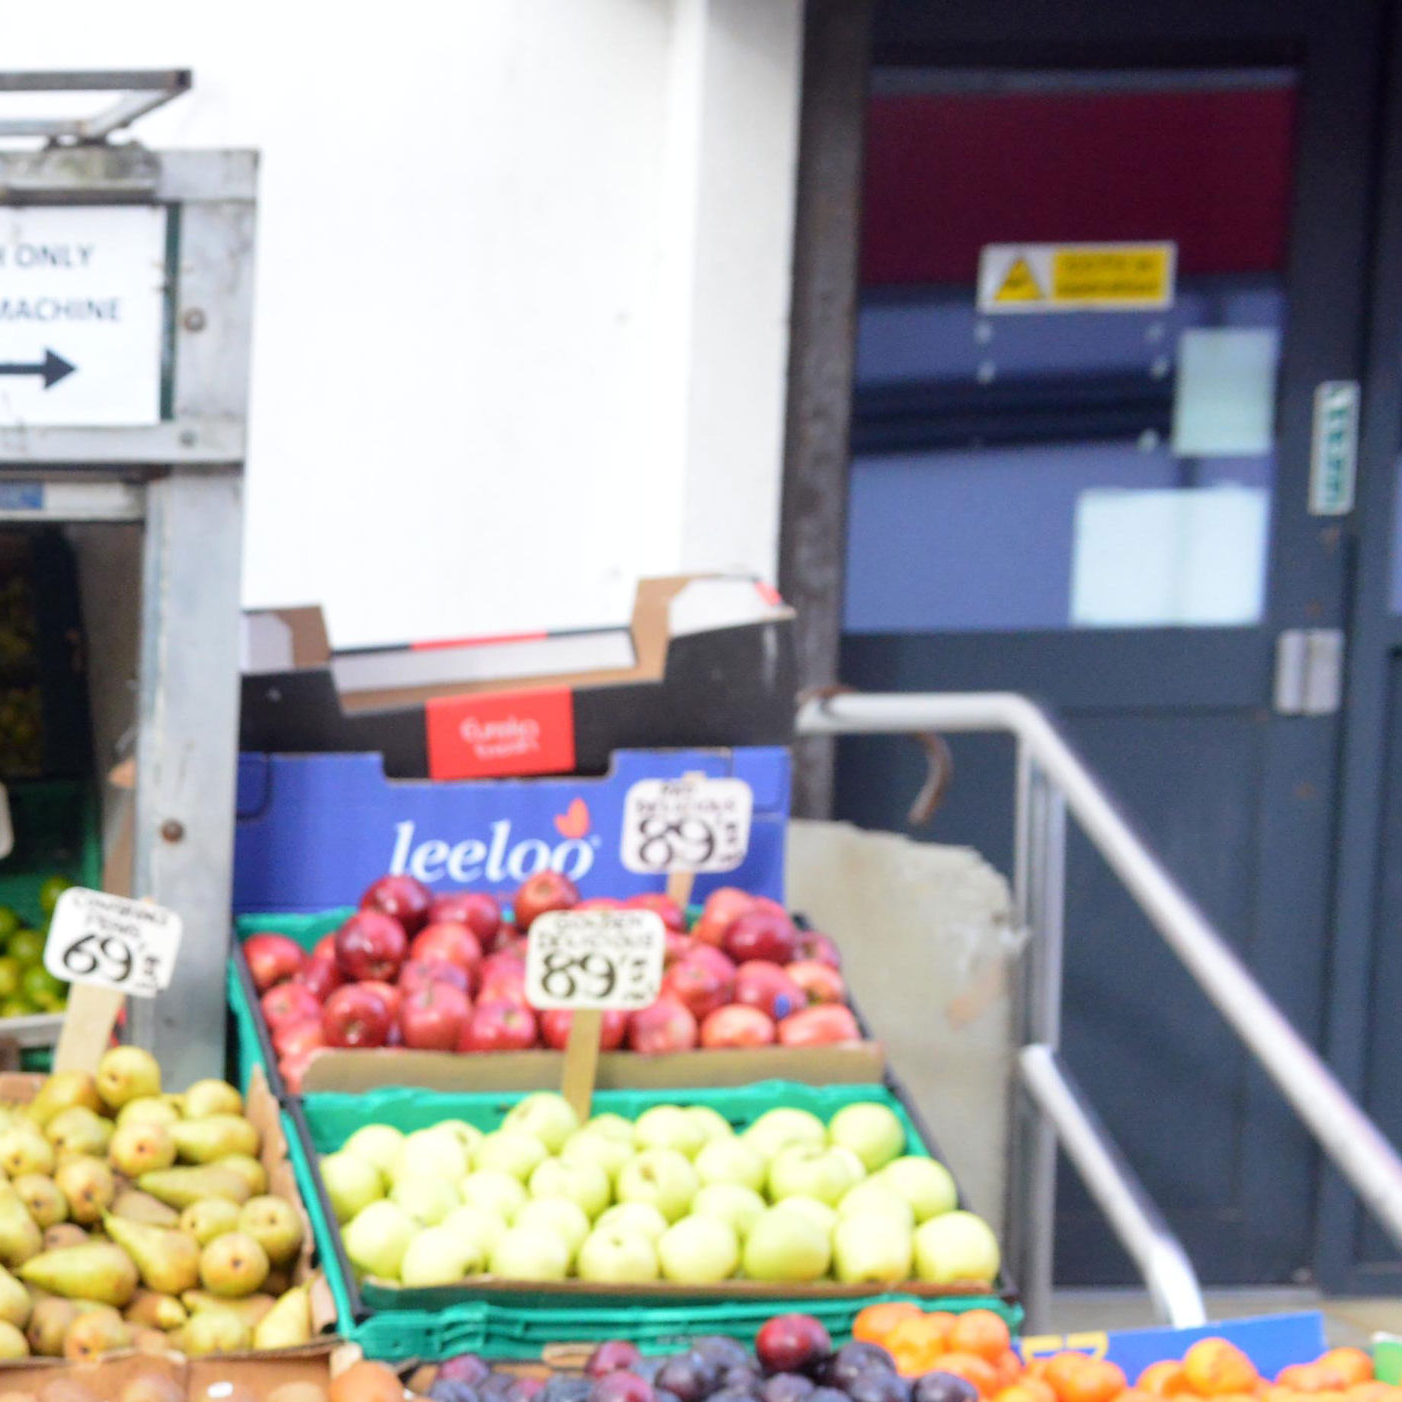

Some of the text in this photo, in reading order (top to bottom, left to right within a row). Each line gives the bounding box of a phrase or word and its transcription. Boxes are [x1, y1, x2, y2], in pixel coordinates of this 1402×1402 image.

[14, 243, 93, 270] ONLY
[389, 818, 595, 883] leeloo
[639, 819, 715, 867] 89
[62, 934, 133, 983] 69
[540, 953, 616, 999] 89
